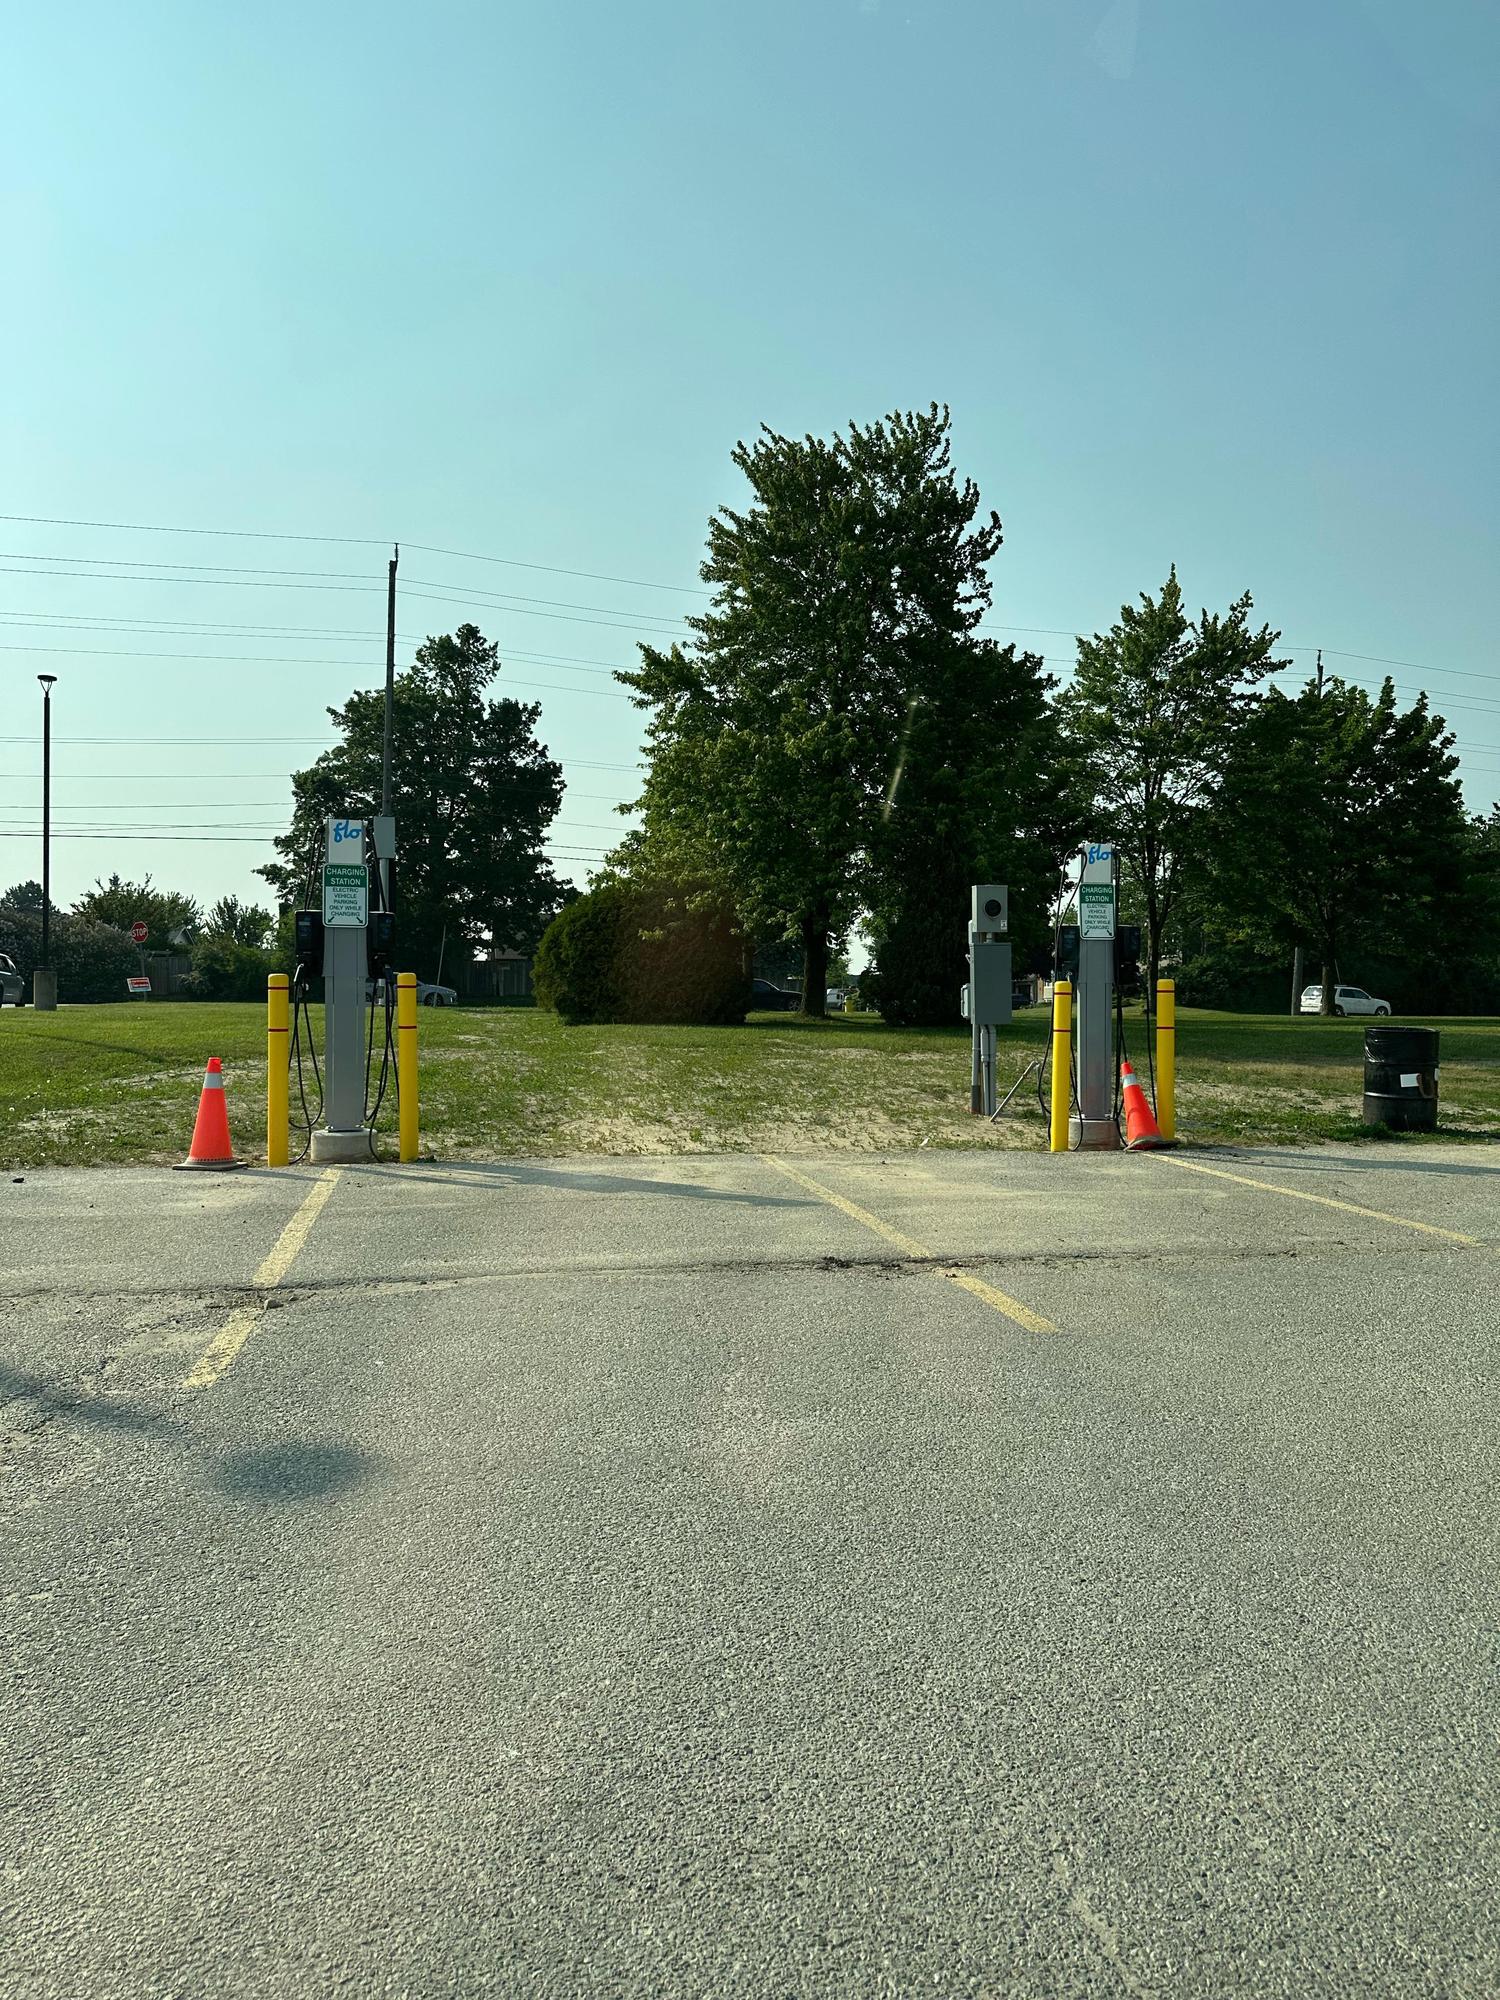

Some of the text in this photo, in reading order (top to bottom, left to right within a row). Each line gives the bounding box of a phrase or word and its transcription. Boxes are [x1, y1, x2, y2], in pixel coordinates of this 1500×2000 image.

[333, 818, 362, 843] flo
[1088, 844, 1115, 864] flo
[326, 868, 365, 876] CHARGING
[132, 928, 147, 938] STOP
